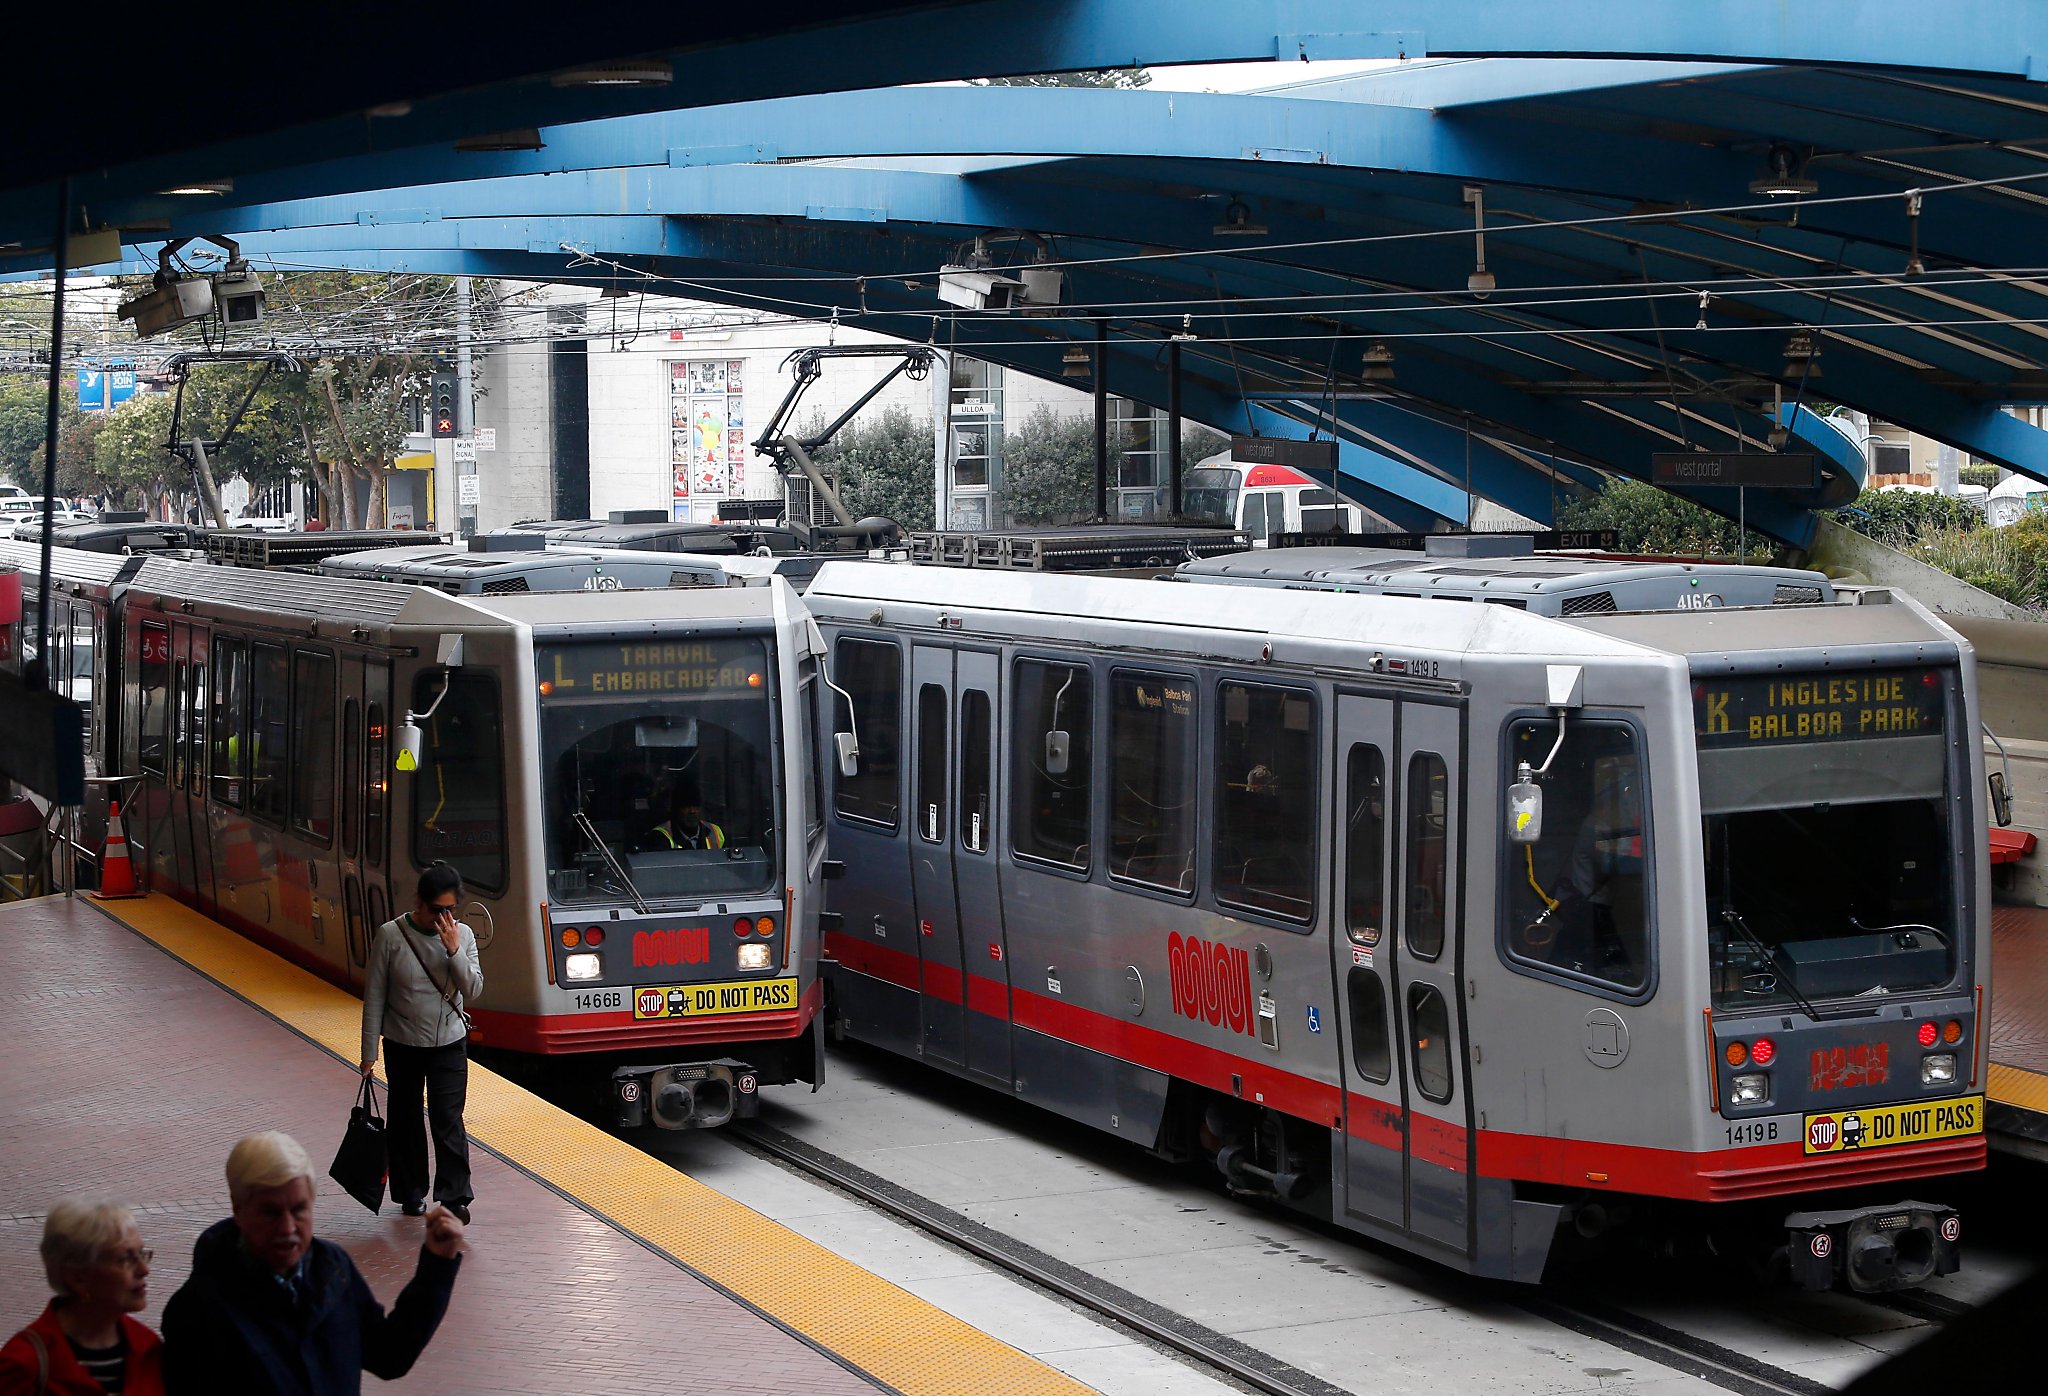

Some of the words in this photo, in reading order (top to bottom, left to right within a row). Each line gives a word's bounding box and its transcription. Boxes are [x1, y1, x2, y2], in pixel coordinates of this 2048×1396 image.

[113, 377, 133, 385] JOIN
[1675, 461, 1695, 477] west
[1697, 458, 1722, 480] portal
[1304, 537, 1337, 547] EXIT
[1389, 538, 1412, 546] WEST
[1561, 533, 1592, 547] EXIT
[621, 645, 718, 666] TARAVAL
[554, 654, 574, 688] L
[1411, 659, 1428, 677] 1419
[592, 667, 746, 692] EMBARCADERO
[1769, 677, 1904, 707] INGLESIDE
[1706, 692, 1729, 734] K
[1749, 711, 1842, 739] BALBOA
[1860, 707, 1919, 732] PARK
[575, 992, 621, 1010] 1466B
[640, 994, 662, 1013] STOP
[696, 990, 715, 1010] DO
[721, 987, 749, 1009] NOT
[754, 984, 790, 1006] PASS
[1873, 1113, 1895, 1140] DO
[1900, 1109, 1931, 1136] NOT
[1936, 1103, 1974, 1131] PASS
[1725, 1123, 1764, 1145] 1419
[1811, 1122, 1836, 1145] STOP
